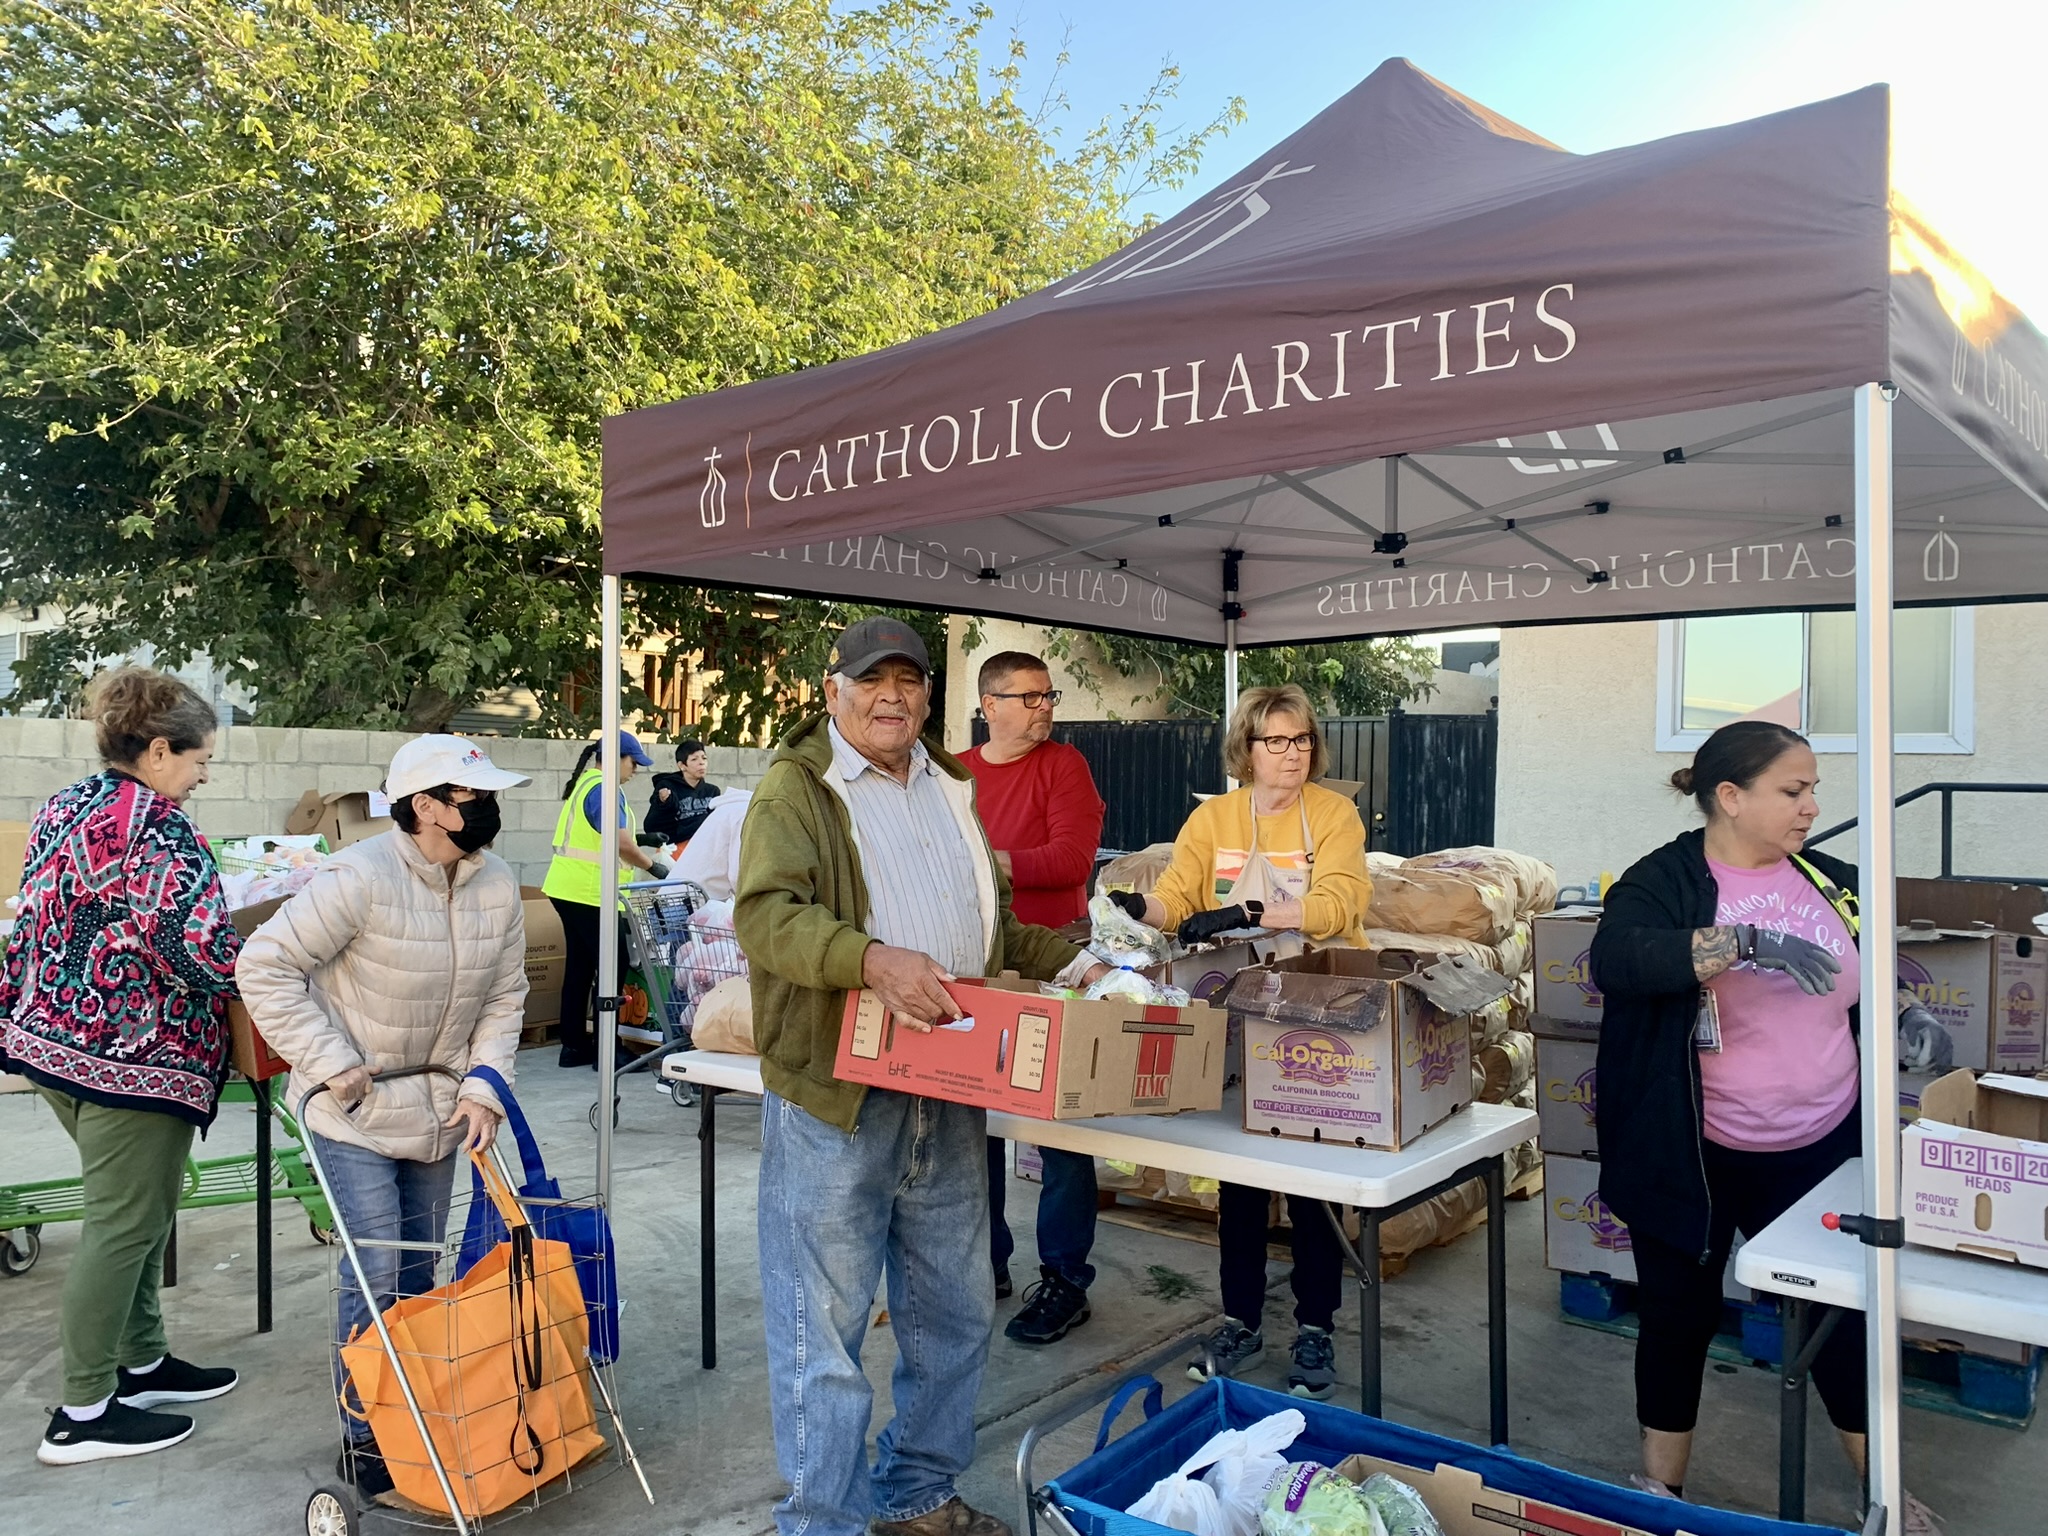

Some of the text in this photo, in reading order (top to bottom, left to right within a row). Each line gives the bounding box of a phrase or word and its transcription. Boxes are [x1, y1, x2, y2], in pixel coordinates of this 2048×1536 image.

[768, 283, 1578, 502] CATHOLIC CHARITIES
[1252, 1041, 1377, 1072] Cal-Organic
[1135, 1076, 1170, 1098] HMC
[1272, 1084, 1360, 1100] CALIFORNIA BROCCOLI
[1255, 1100, 1273, 1110] NOT
[1274, 1102, 1292, 1112] FOR
[1293, 1104, 1327, 1116] EXPORT
[1328, 1107, 1340, 1117] TO
[1341, 1109, 1380, 1122] CANADA
[1928, 1145, 1938, 1160] 9
[1954, 1149, 1975, 1166] 12
[1991, 1155, 2012, 1172] 16
[1965, 1175, 2012, 1194] HEADS
[1915, 1192, 1959, 1207] PRODUCE
[1915, 1203, 1959, 1218] OF U.S.A.
[1777, 1273, 1812, 1286] LIFETIME
